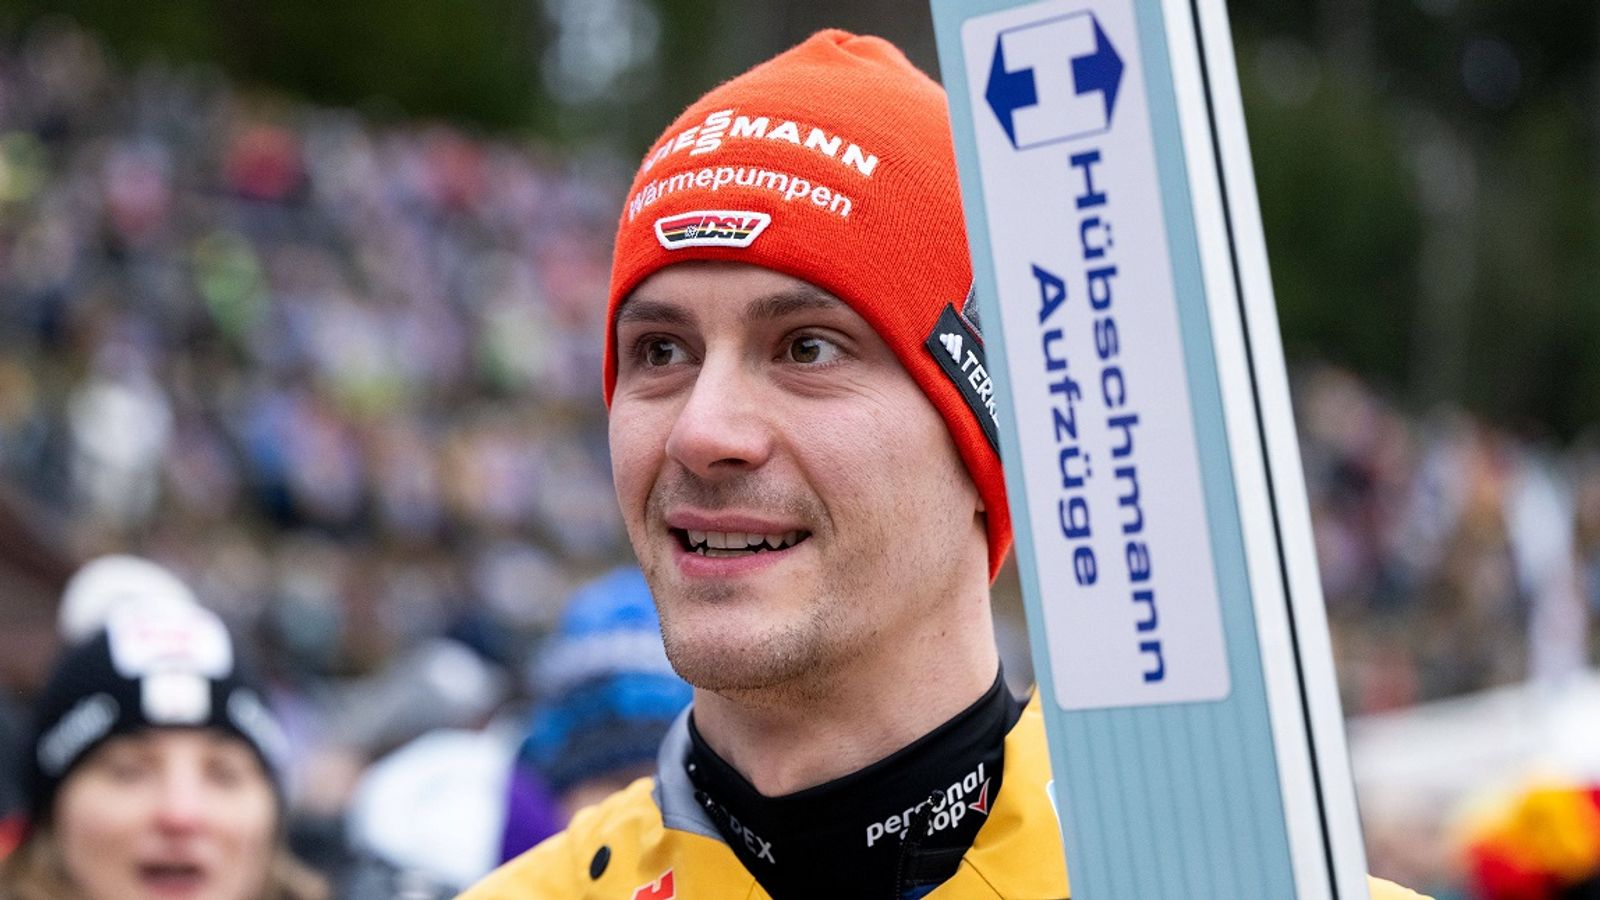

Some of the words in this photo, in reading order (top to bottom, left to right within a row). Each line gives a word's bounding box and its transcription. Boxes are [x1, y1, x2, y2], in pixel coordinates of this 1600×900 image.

[643, 109, 878, 177] VIESSMANN
[629, 167, 852, 222] Wärmepumpen
[698, 216, 761, 240] DSV
[1031, 262, 1097, 586] Aufzüge
[1070, 150, 1166, 683] Hübschmann
